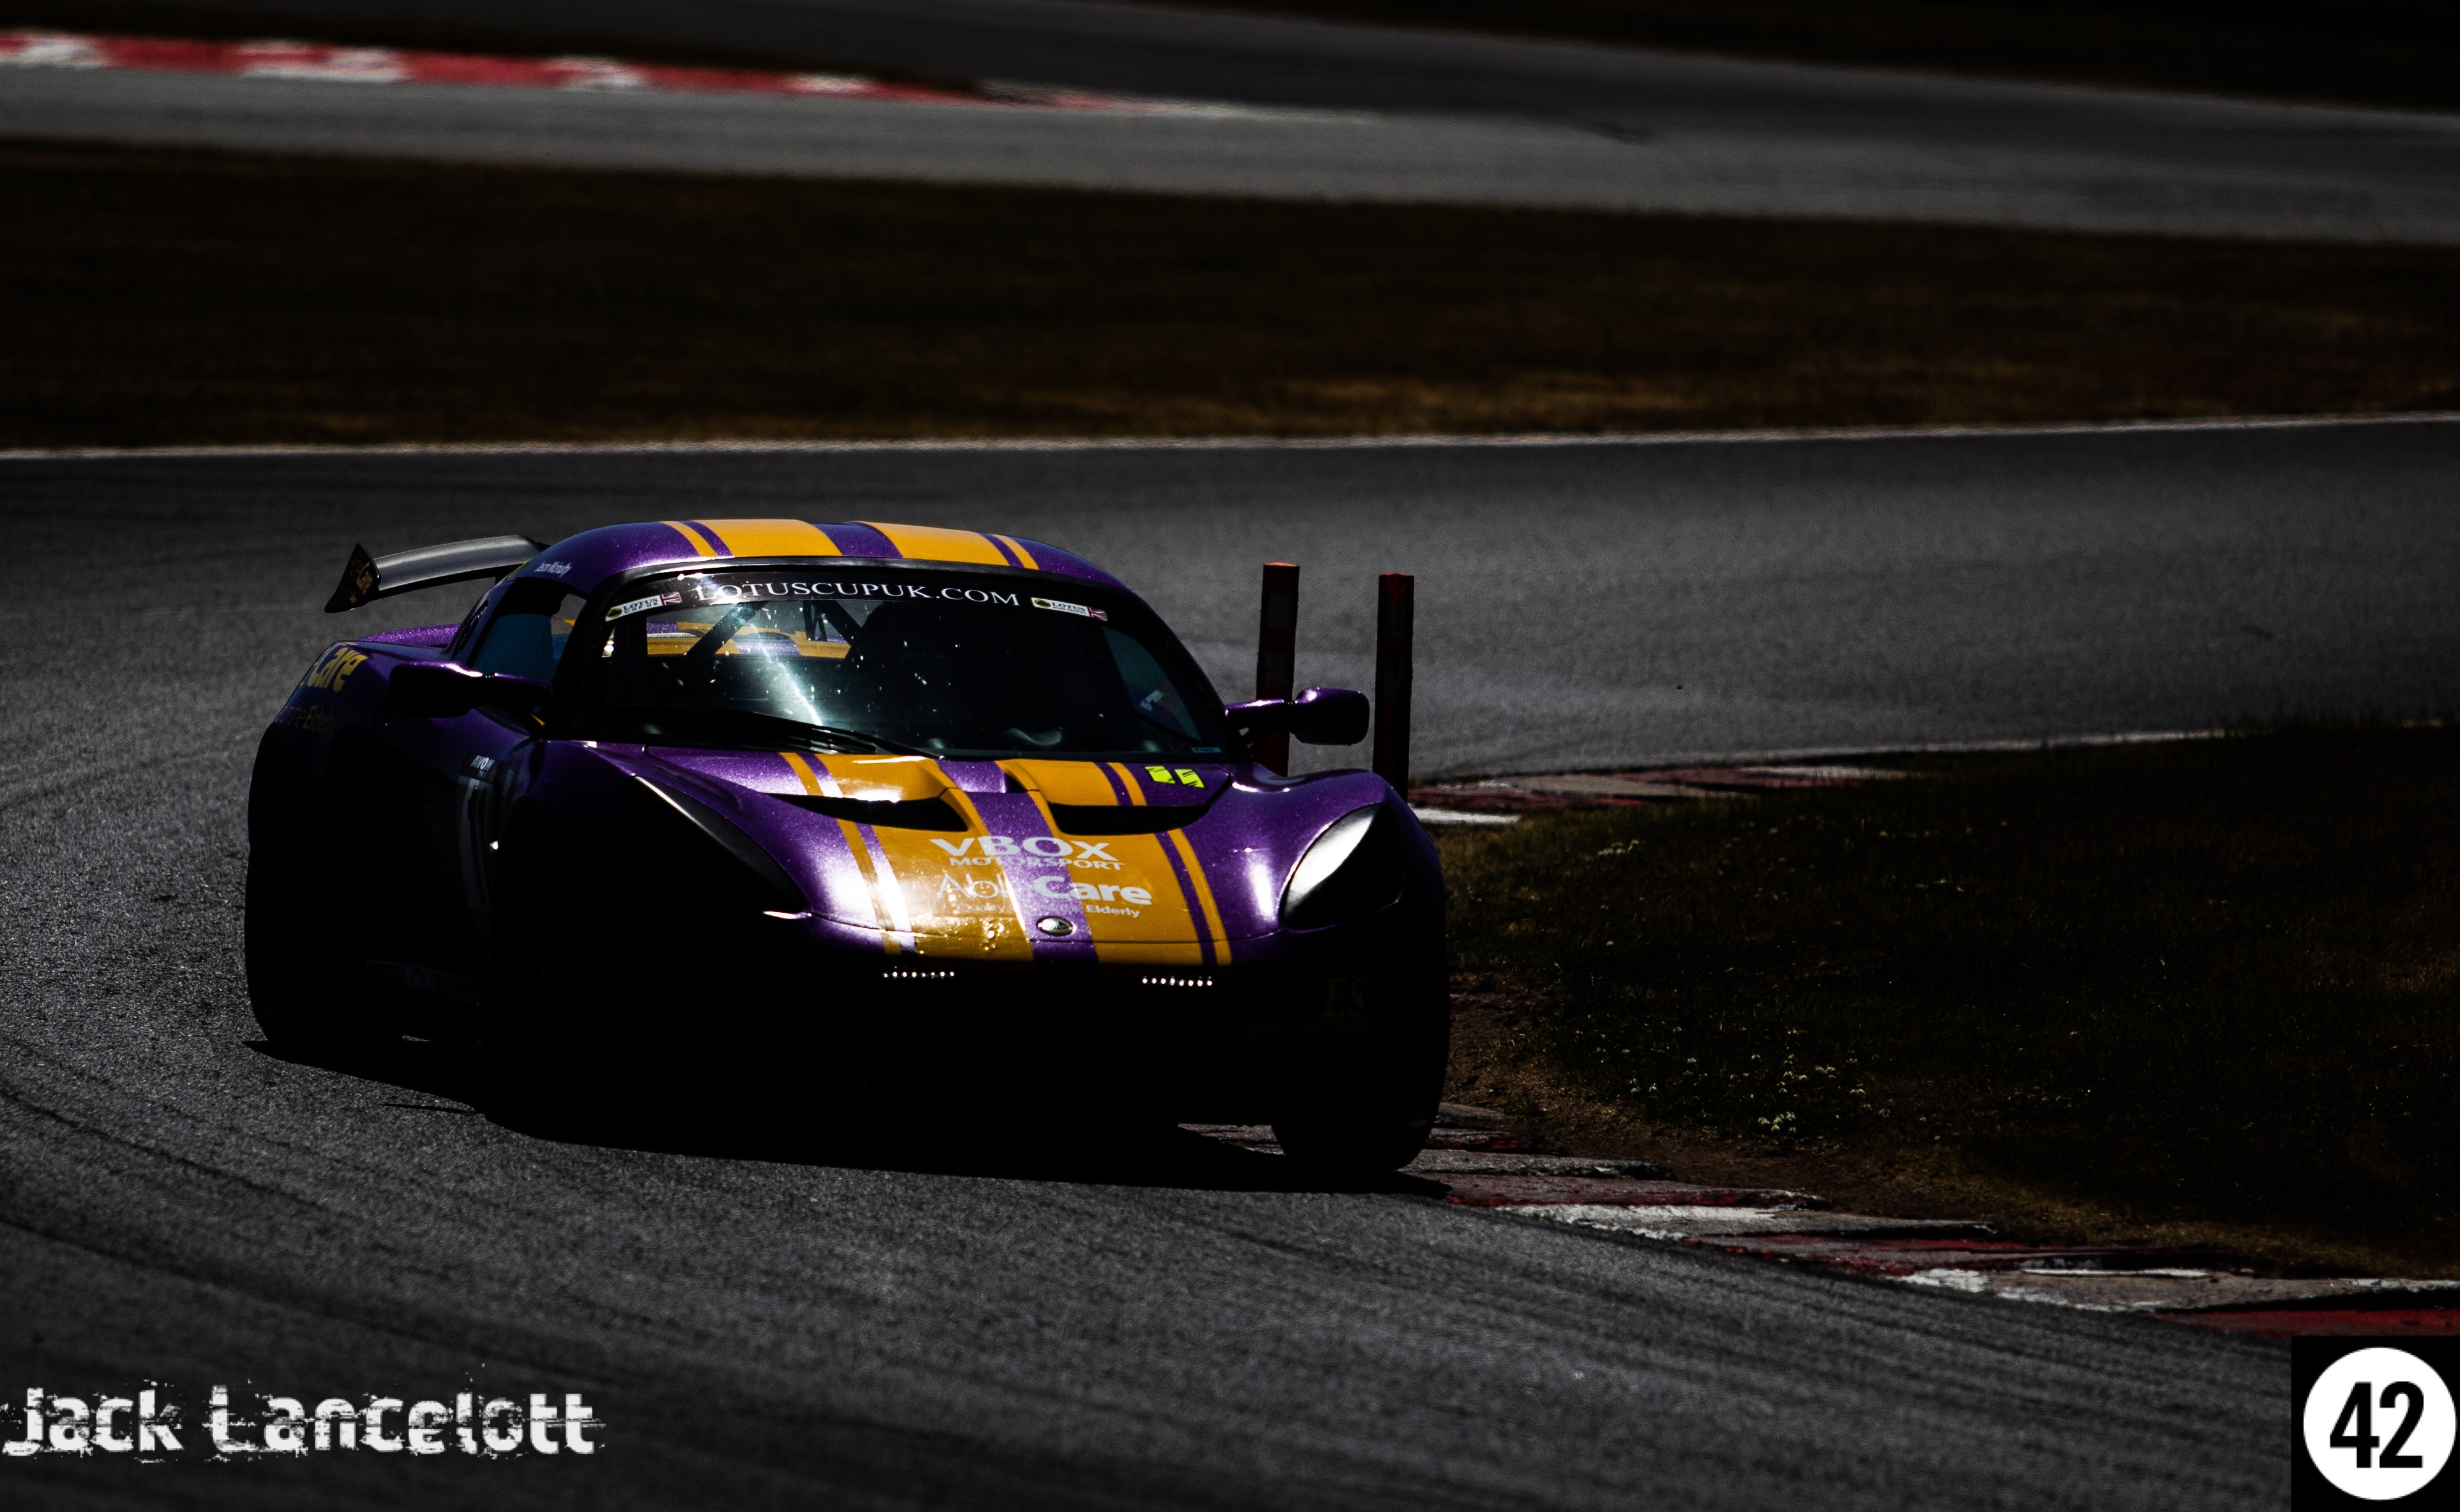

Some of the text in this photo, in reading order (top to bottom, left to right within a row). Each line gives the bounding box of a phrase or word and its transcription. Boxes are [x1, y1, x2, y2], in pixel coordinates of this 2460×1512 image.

[696, 581, 1020, 606] LOTUSCUPUK.COM
[623, 598, 658, 611] LOTUS
[929, 836, 1119, 861] VBOX
[950, 857, 1125, 870] MOTORSPORT
[1086, 904, 1140, 918] Elderly
